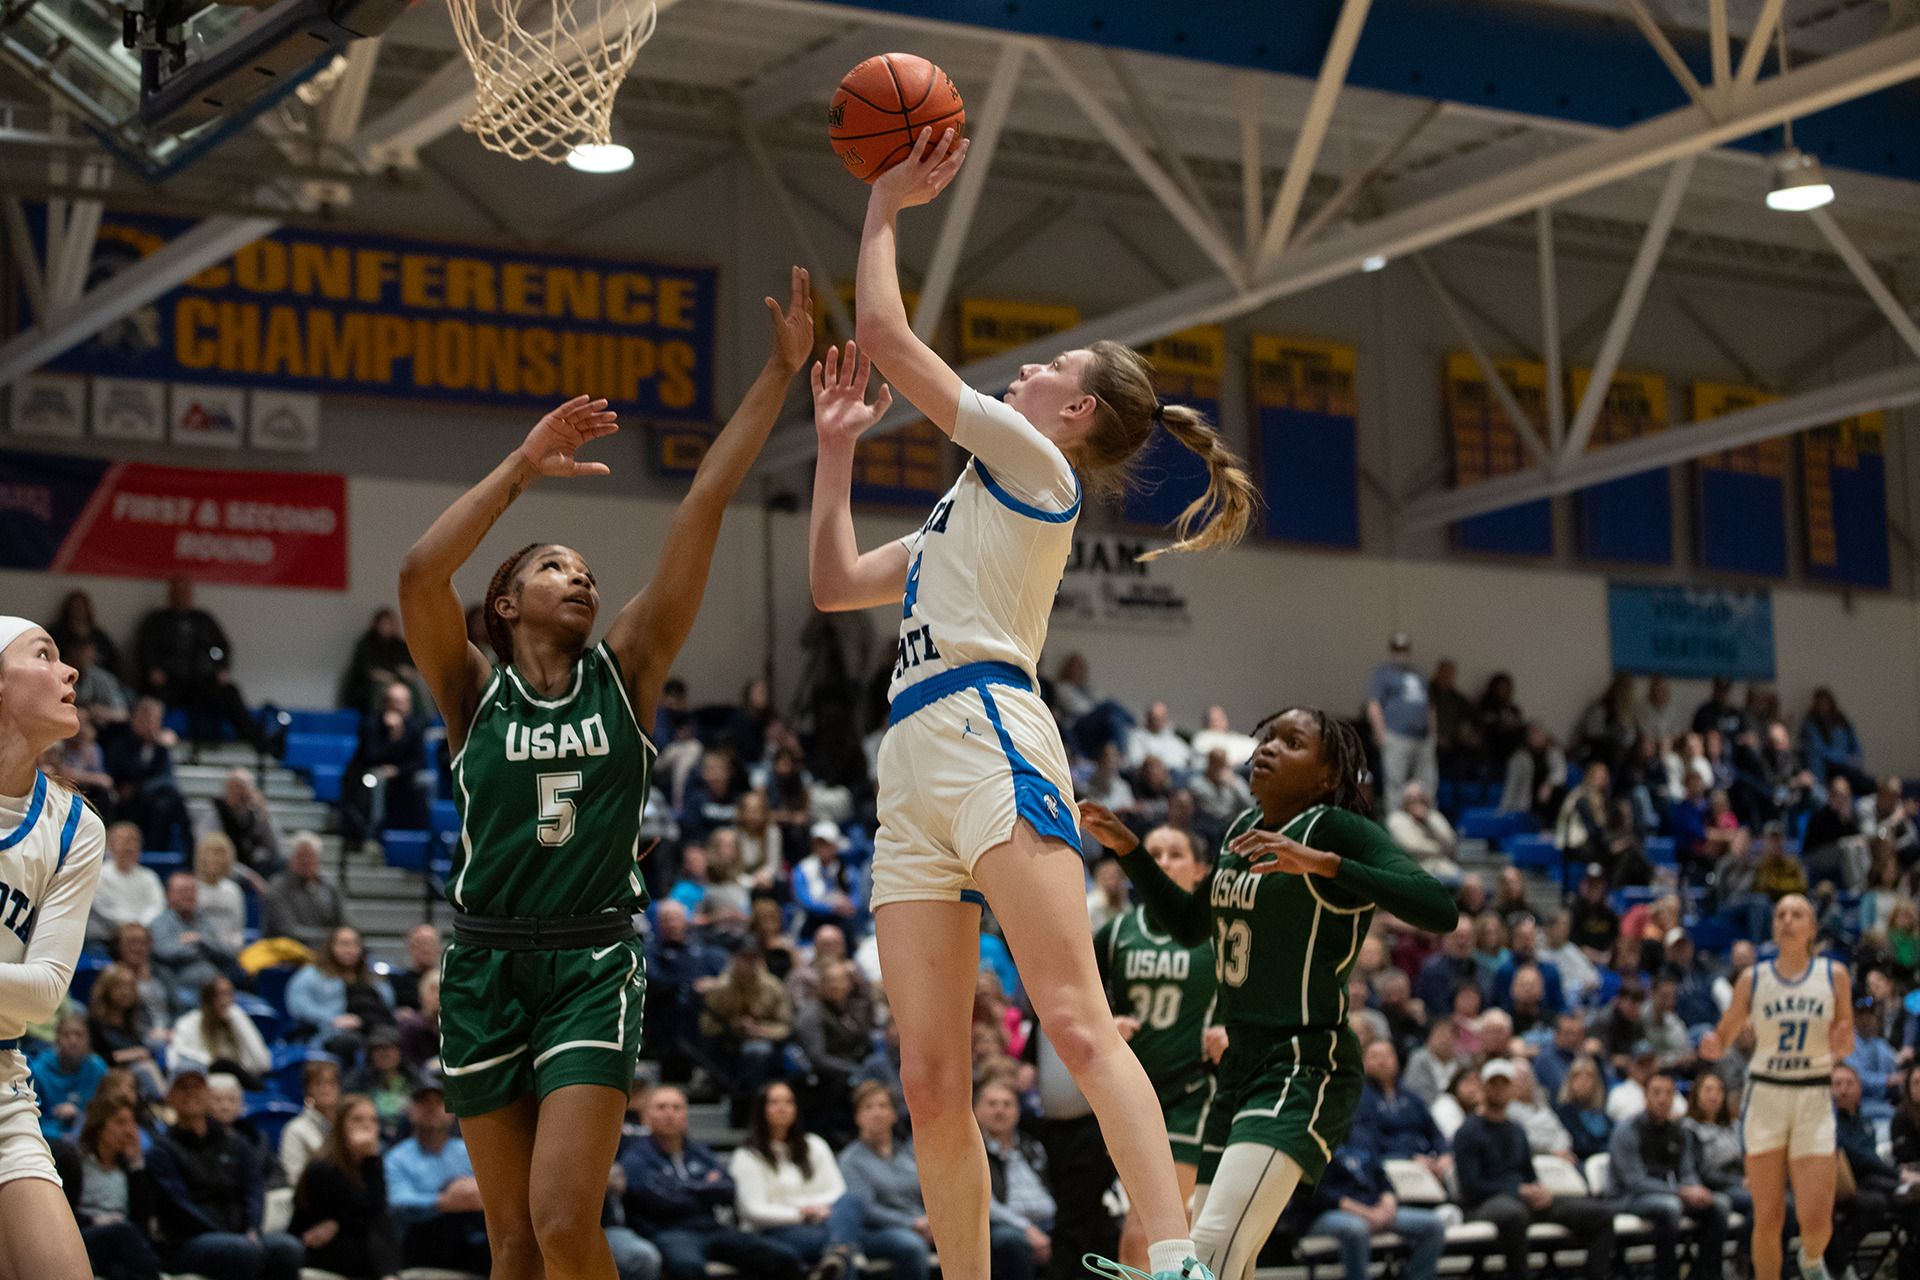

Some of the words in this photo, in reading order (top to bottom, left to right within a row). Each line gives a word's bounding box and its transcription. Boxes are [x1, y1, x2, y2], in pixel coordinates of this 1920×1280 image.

[176, 297, 695, 408] CHAMPIONSHIPS
[113, 493, 193, 525] FIRST
[196, 499, 219, 527] &
[225, 501, 336, 536] SECOND
[175, 531, 275, 564] ROUND
[506, 713, 610, 761] USAO
[536, 771, 582, 847] 5
[1210, 868, 1262, 911] USAO
[1124, 951, 1191, 980] USAO
[1128, 983, 1184, 1031] 30
[1763, 997, 1824, 1019] DAKOTA
[1778, 1021, 1808, 1051] 21
